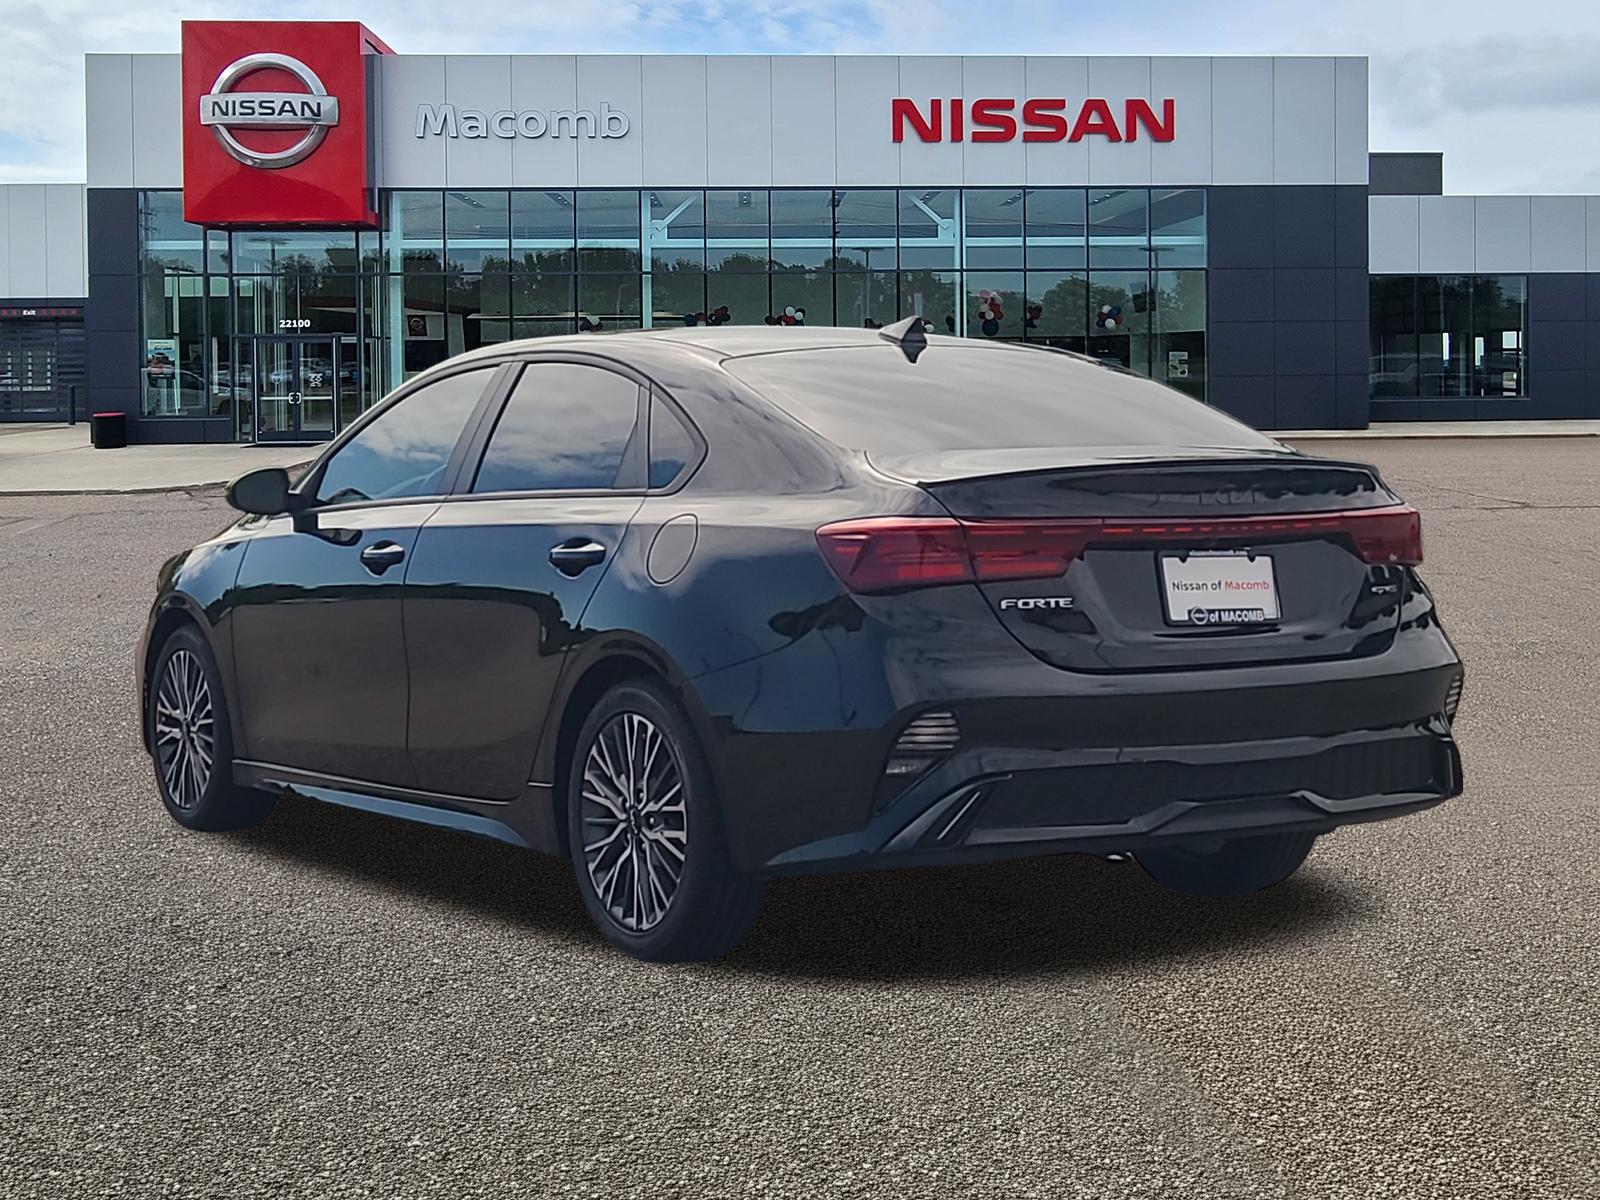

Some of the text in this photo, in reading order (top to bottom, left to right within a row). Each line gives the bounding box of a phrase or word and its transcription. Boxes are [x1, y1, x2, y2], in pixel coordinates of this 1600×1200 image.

[212, 99, 322, 118] NISSAN
[415, 101, 630, 139] Macomb
[892, 98, 1175, 143] NISSAN
[279, 319, 311, 328] 22100
[1172, 580, 1270, 591] Nissan of Macomb
[1000, 597, 1073, 610] FORTE
[1209, 611, 1219, 622] of
[1220, 610, 1264, 622] MACOMB
